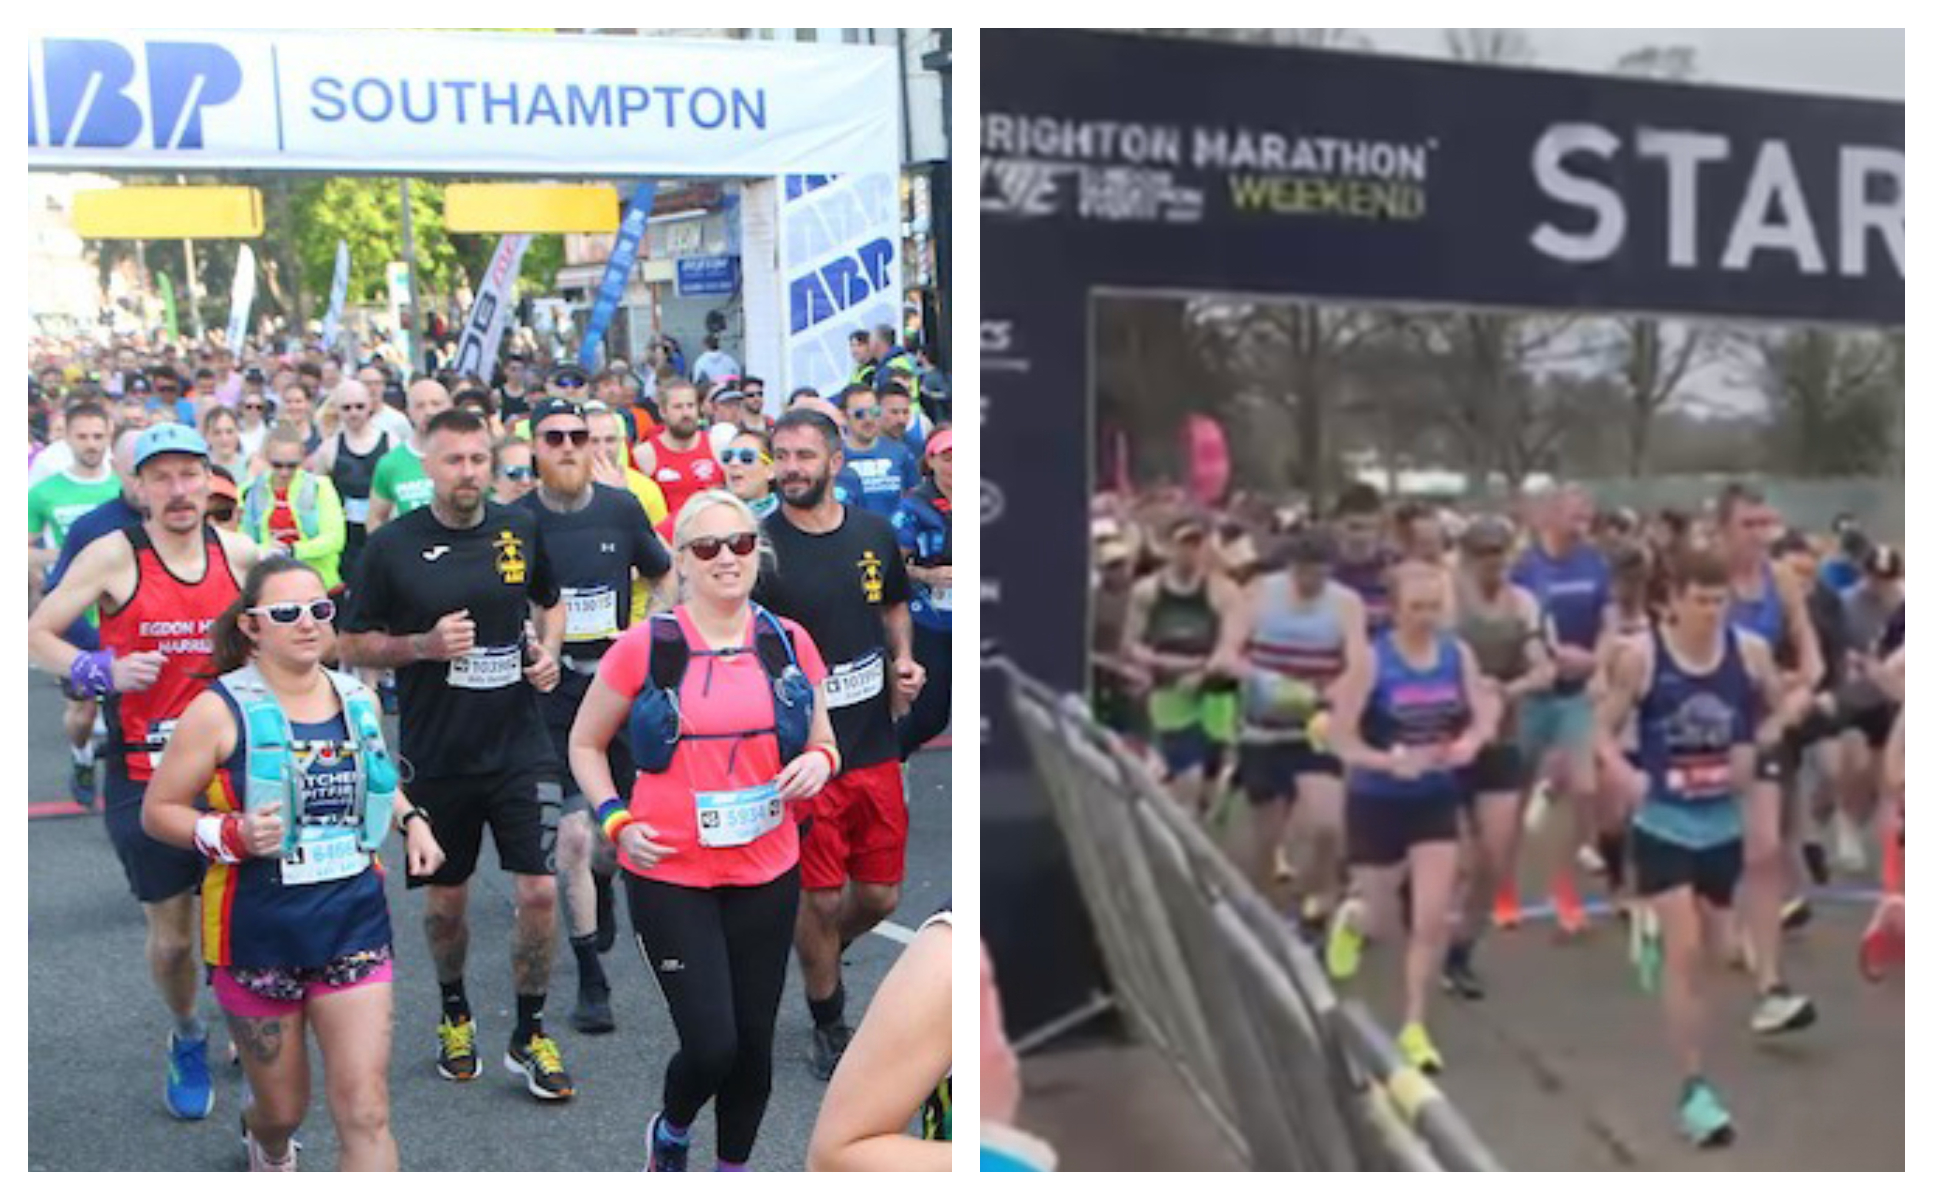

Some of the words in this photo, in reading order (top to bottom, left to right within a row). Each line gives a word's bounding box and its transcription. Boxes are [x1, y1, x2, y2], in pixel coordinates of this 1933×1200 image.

[28, 37, 243, 149] BP
[310, 75, 768, 130] SOUTHAMPTON
[980, 114, 1181, 164] RIGHTON
[1192, 128, 1428, 181] MARATHON
[1229, 172, 1427, 220] WEEKEND
[1529, 121, 1905, 279] STAR
[790, 236, 894, 336] ABP
